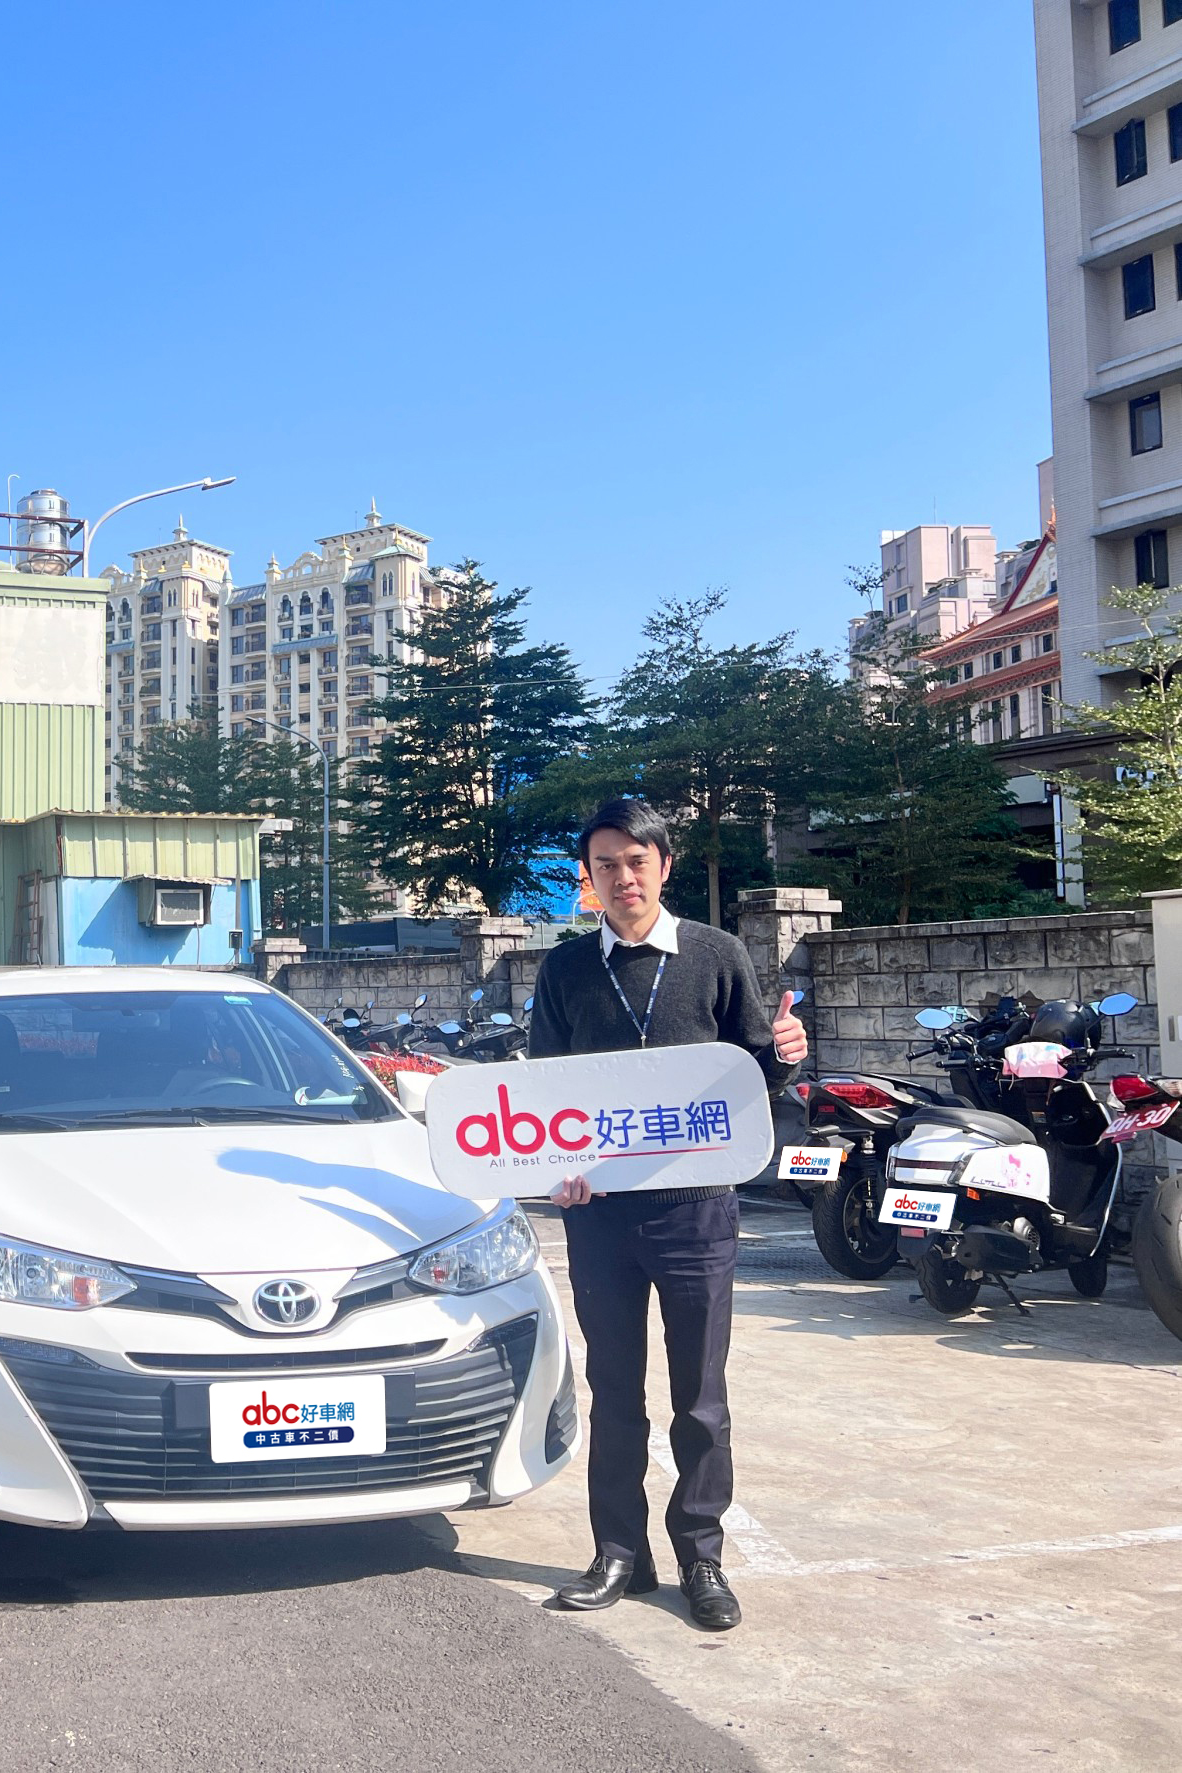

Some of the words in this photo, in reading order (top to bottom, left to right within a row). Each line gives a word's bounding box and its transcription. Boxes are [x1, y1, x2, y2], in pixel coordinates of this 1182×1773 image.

[455, 1083, 732, 1157] abc好車網
[489, 1158, 506, 1168] All
[513, 1156, 540, 1166] Best
[548, 1152, 596, 1164] Choice
